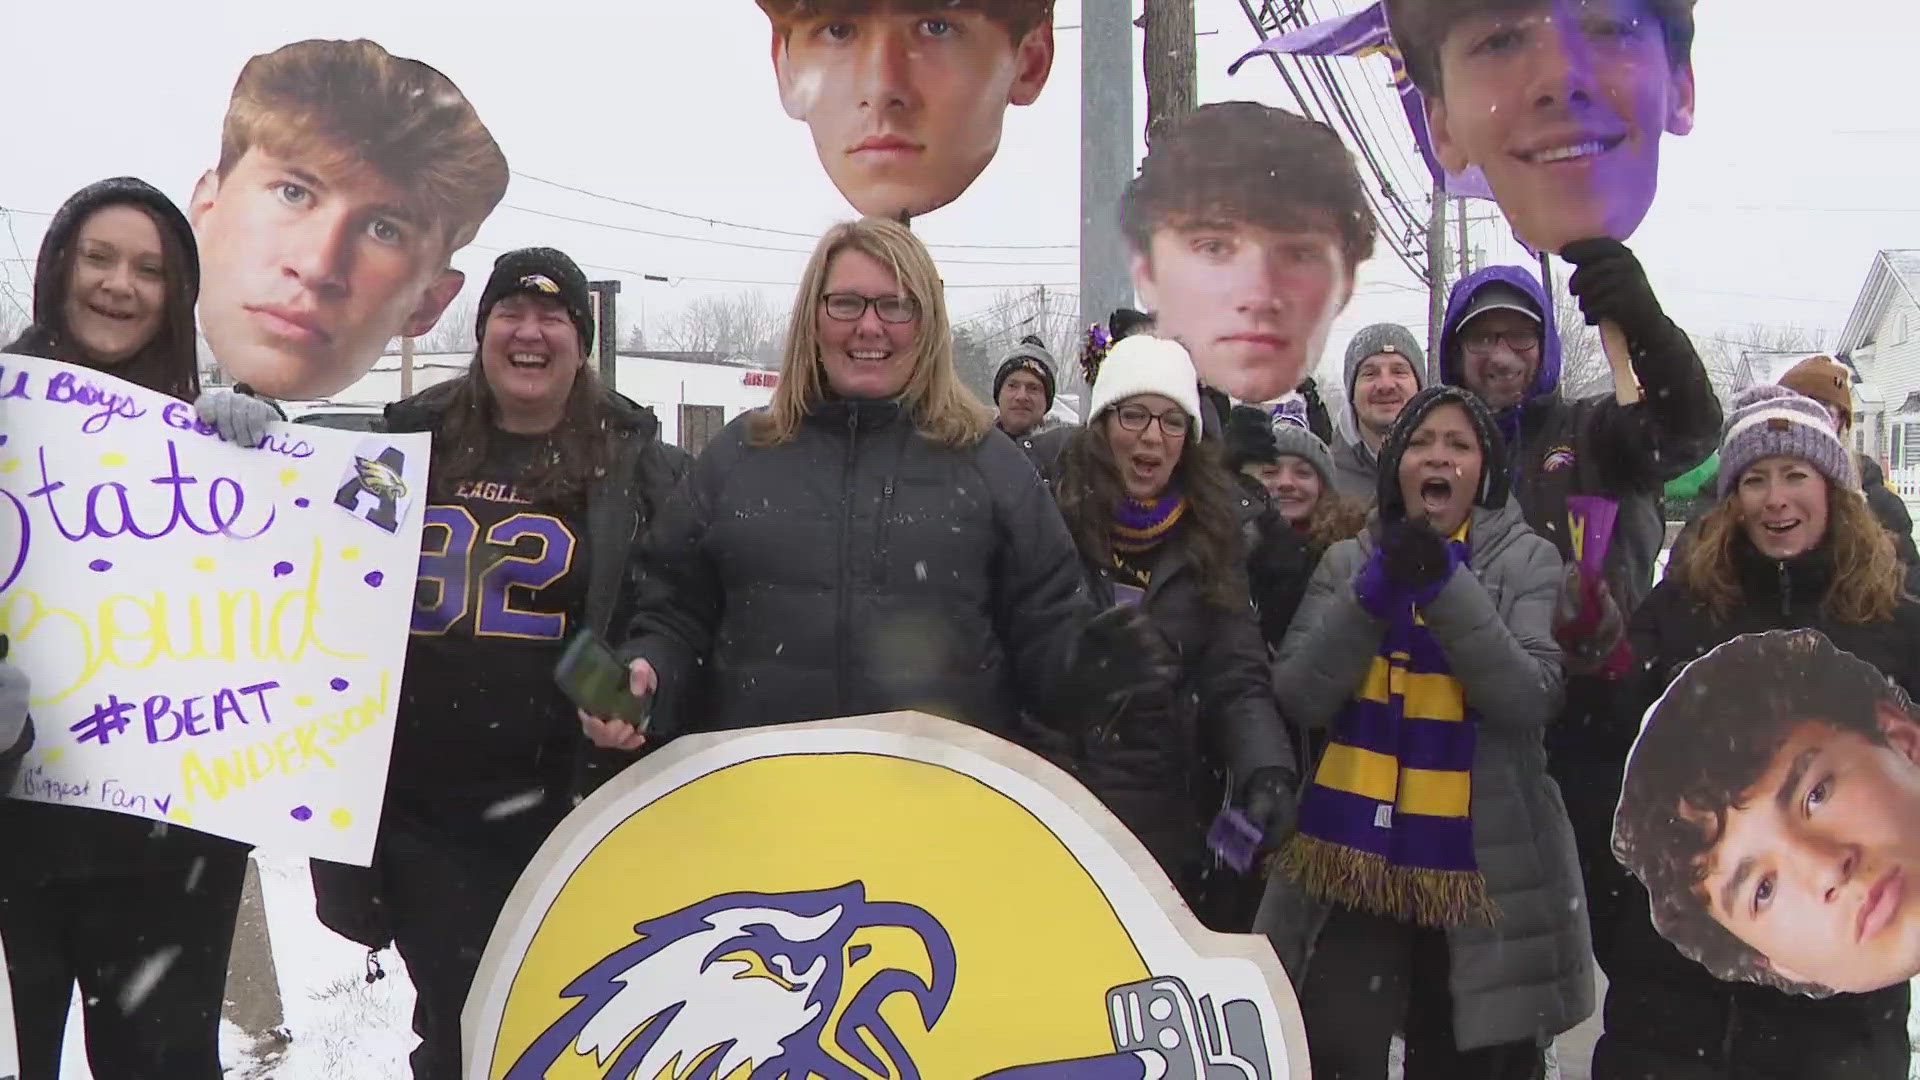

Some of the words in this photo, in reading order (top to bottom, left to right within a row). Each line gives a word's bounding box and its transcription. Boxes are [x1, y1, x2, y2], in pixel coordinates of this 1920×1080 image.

[46, 371, 147, 434] Boys
[69, 681, 280, 744] #BEAT
[181, 669, 389, 804] ANDERSON
[101, 779, 146, 813] Fan
